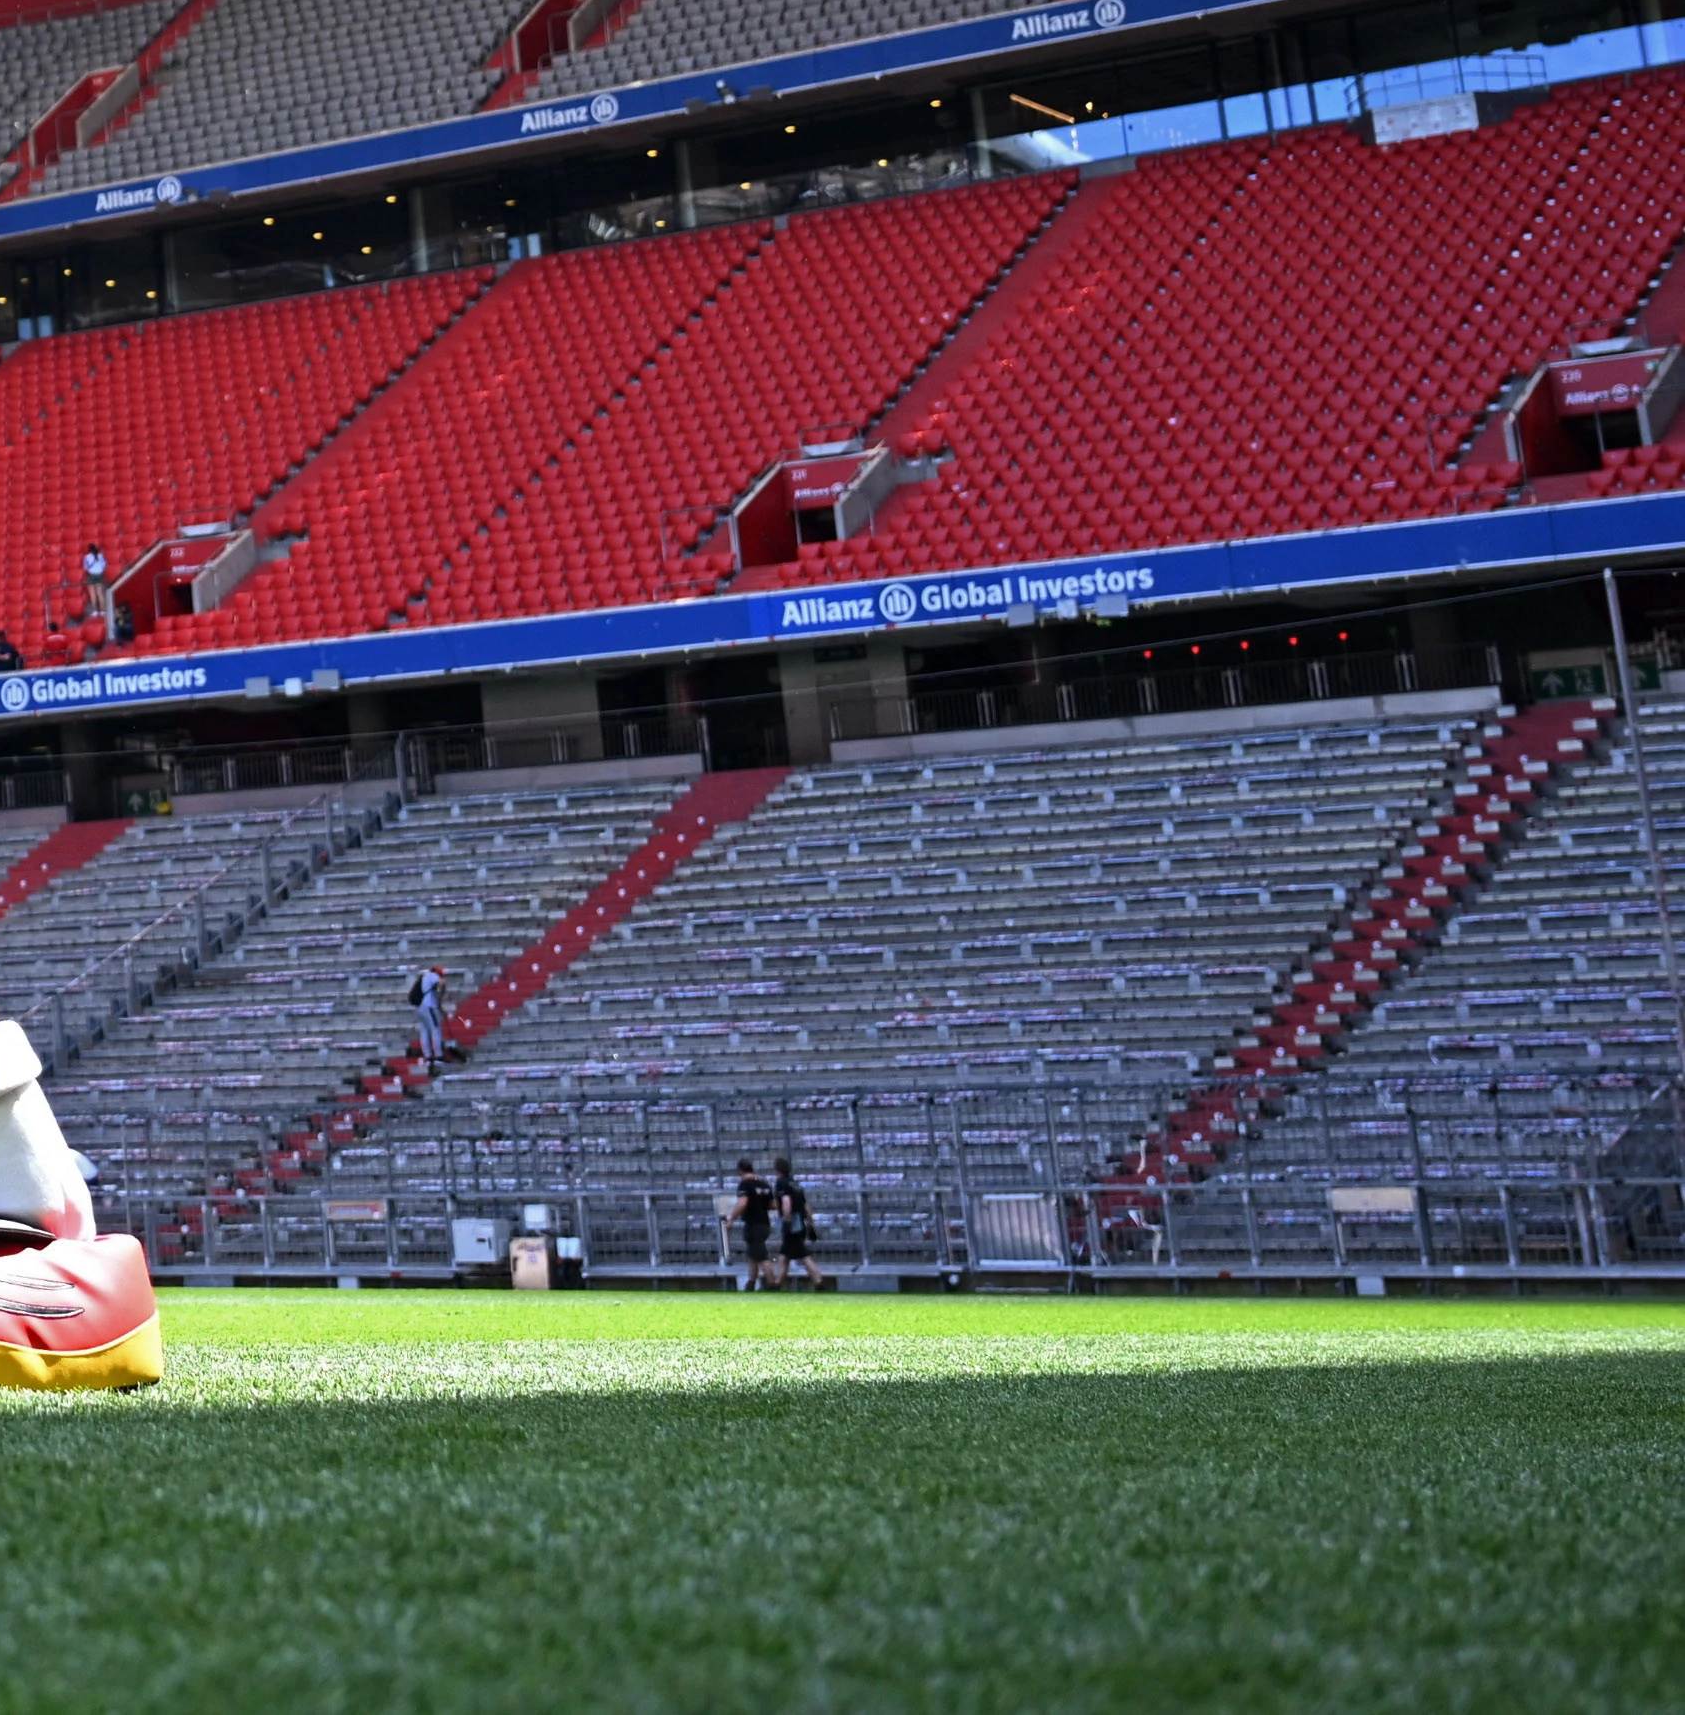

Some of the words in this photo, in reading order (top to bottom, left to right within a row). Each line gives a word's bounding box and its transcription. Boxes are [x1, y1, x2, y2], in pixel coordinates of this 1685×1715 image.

[1011, 6, 1090, 40] Allianz
[521, 104, 588, 133] Allianz
[95, 183, 154, 212] Allianz
[782, 589, 874, 627] Allianz
[921, 573, 1004, 611] Global
[1018, 564, 1155, 604] Investors
[32, 673, 101, 701] Global
[105, 664, 207, 695] Investors
